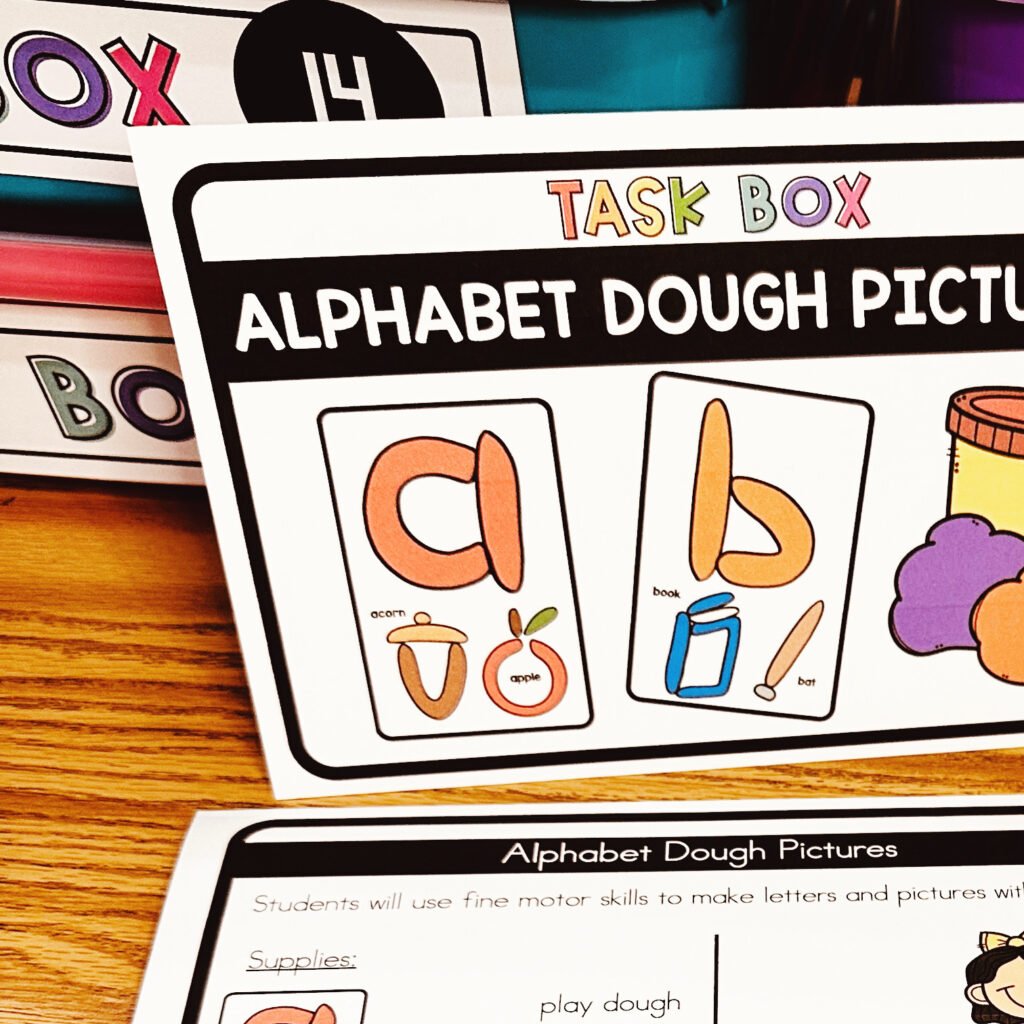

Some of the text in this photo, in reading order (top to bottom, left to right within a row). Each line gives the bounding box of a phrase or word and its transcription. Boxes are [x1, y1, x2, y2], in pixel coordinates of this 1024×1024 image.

[0, 30, 379, 127] OX 14
[546, 170, 874, 240] TASK BOX
[235, 279, 577, 353] ALPHABET
[601, 269, 829, 336] DOUGH
[26, 354, 196, 442] BO
[652, 585, 681, 600] book
[370, 609, 407, 620] acorn
[509, 672, 542, 685] apple
[797, 675, 817, 687] bat
[501, 838, 898, 871] Alphabet Dough Pictures
[253, 894, 360, 913] Students
[369, 892, 402, 911] will
[412, 898, 453, 910] use
[463, 890, 510, 908] fine
[518, 893, 591, 907] motor
[600, 888, 649, 907] skills
[658, 891, 683, 905] to
[691, 886, 755, 905] make
[764, 885, 837, 904] letters
[845, 883, 889, 902] and
[897, 886, 987, 908] pictures
[245, 949, 358, 976] Supplies:
[539, 990, 681, 1023] play dough
